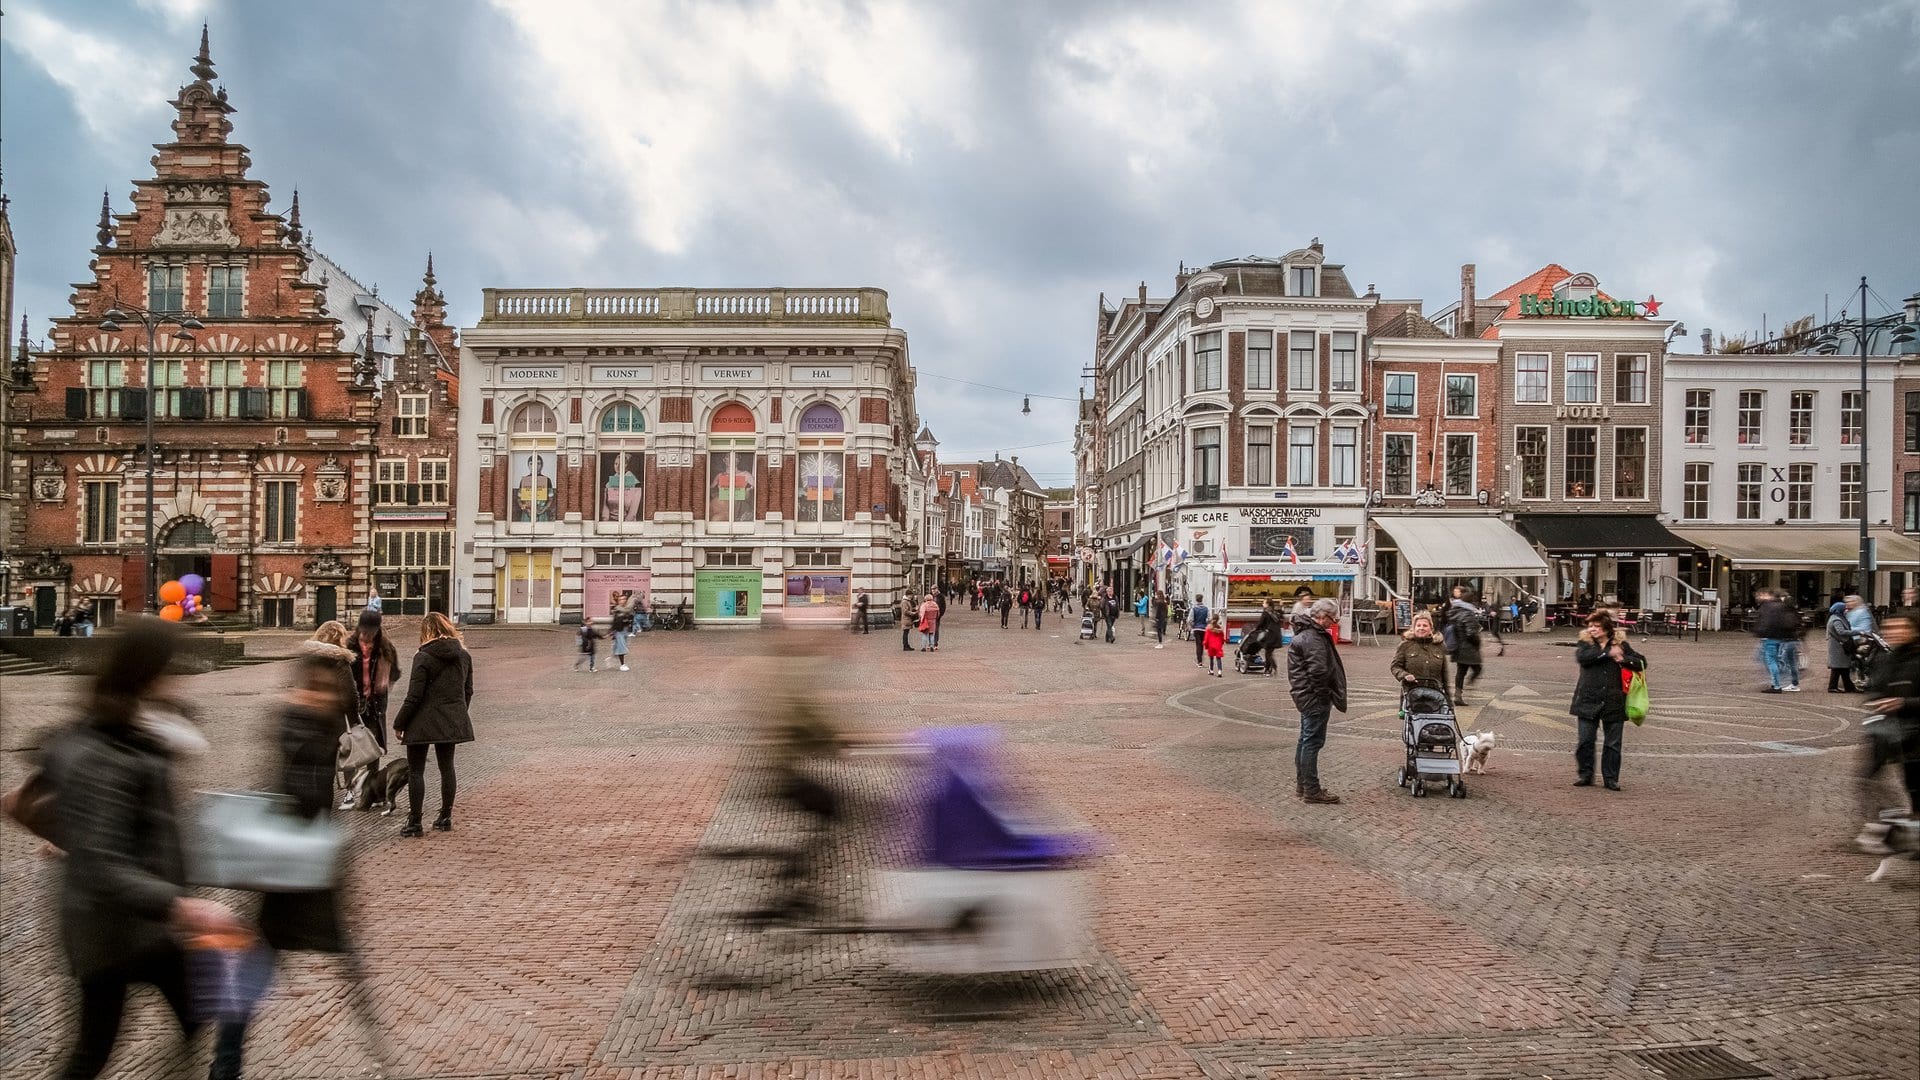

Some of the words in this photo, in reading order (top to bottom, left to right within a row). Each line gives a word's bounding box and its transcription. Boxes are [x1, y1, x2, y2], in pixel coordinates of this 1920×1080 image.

[1519, 295, 1636, 318] Heineken
[509, 370, 558, 379] MODERNE
[606, 370, 639, 379] KUNST
[713, 370, 753, 379] VERWEY
[812, 370, 831, 379] HAL
[1556, 405, 1611, 419] HOTEL
[1181, 513, 1199, 523] SHOE
[1202, 512, 1229, 522] CARE
[1239, 508, 1321, 518] VAKSCHOENMAKERIJ
[1251, 517, 1309, 525] SLEUTELSERVICE
